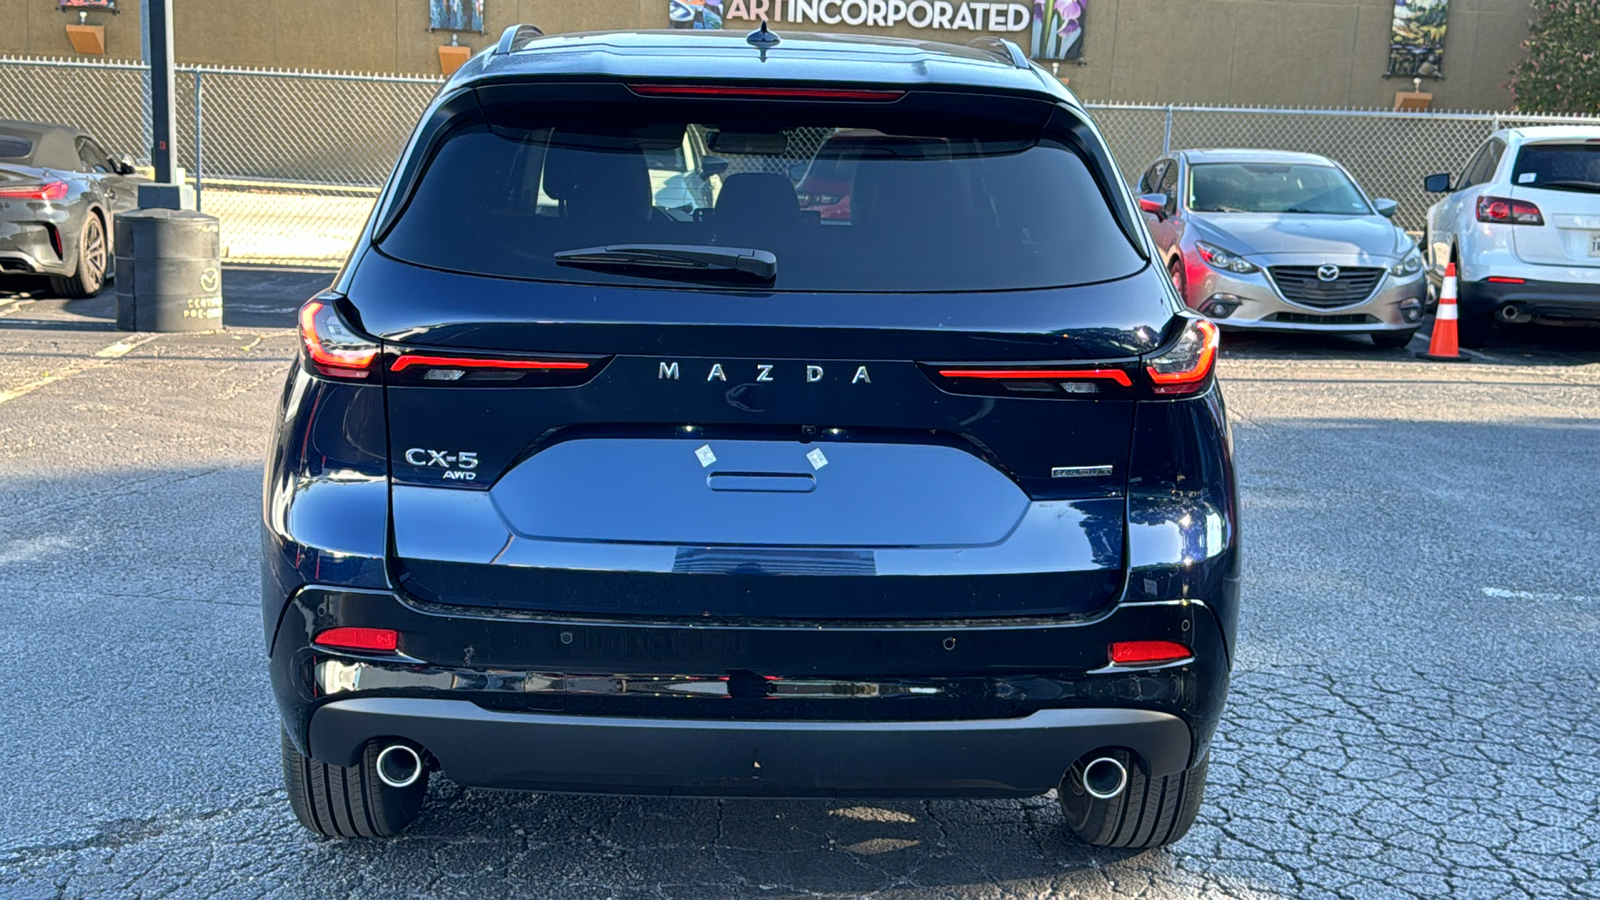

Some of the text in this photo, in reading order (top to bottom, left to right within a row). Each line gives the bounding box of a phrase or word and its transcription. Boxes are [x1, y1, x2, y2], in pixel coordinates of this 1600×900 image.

[658, 362, 872, 384] MAZDA
[405, 447, 479, 470] CX-5
[442, 470, 477, 480] AWD
